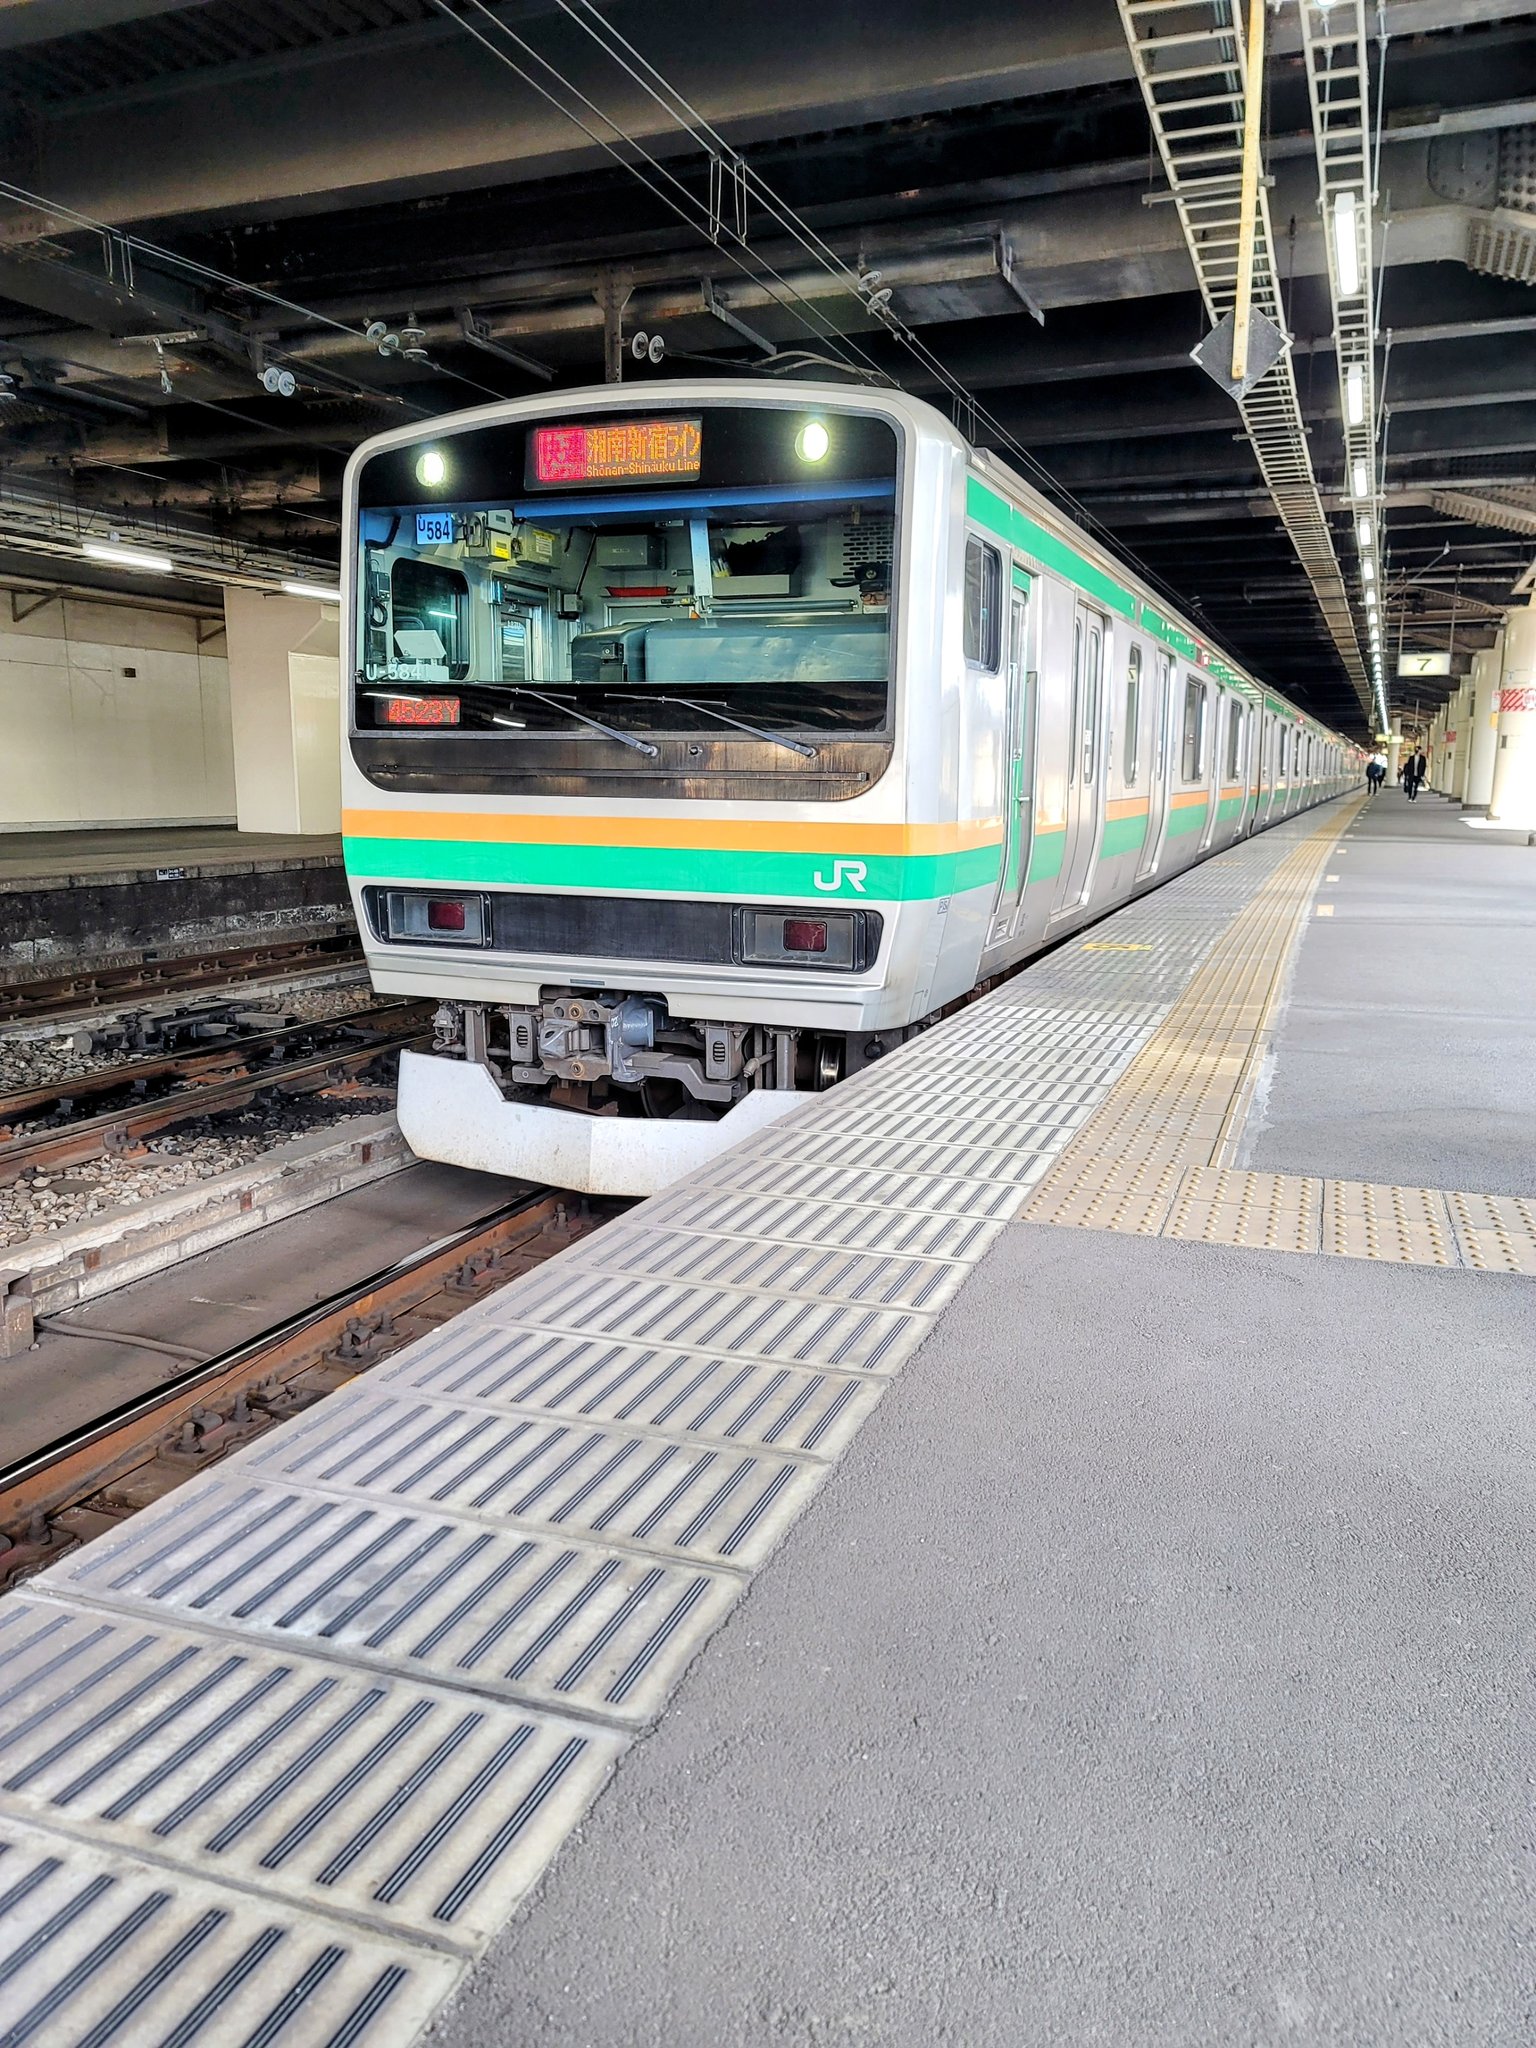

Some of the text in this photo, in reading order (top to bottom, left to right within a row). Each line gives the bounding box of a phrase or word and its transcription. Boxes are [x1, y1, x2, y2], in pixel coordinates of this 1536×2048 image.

[677, 458, 701, 472] Line
[365, 662, 422, 681] U-584
[1417, 658, 1432, 671] 7
[388, 698, 461, 723] 4523Y
[813, 859, 868, 893] JR
